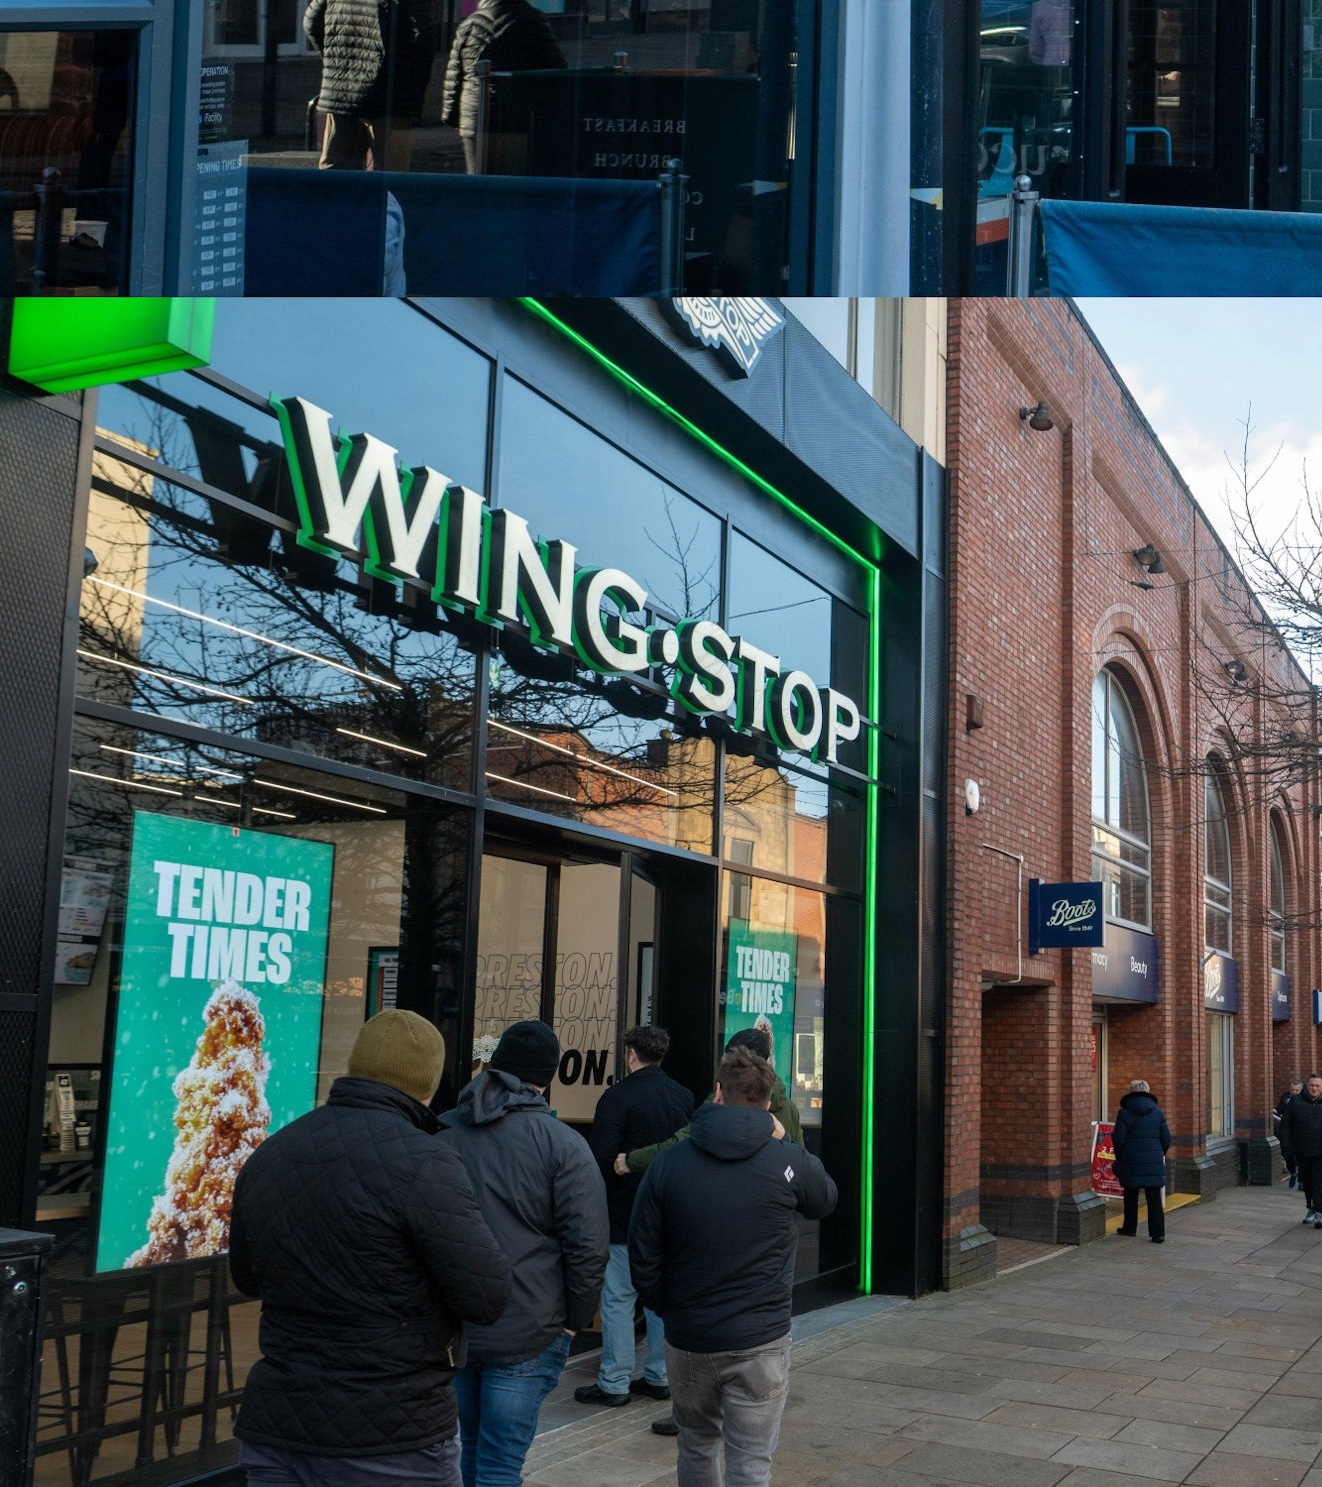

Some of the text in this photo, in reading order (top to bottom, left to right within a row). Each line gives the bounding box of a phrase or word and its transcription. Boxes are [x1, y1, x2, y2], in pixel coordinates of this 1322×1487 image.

[200, 66, 229, 78] OPERATION
[198, 158, 242, 174] ENING TIMES
[153, 860, 311, 933] TENDER
[1046, 899, 1097, 926] Boots
[168, 923, 293, 985] TIMES
[736, 945, 790, 983] TENDER
[1091, 953, 1148, 979] macy Beauty
[741, 980, 784, 1015] TIMES
